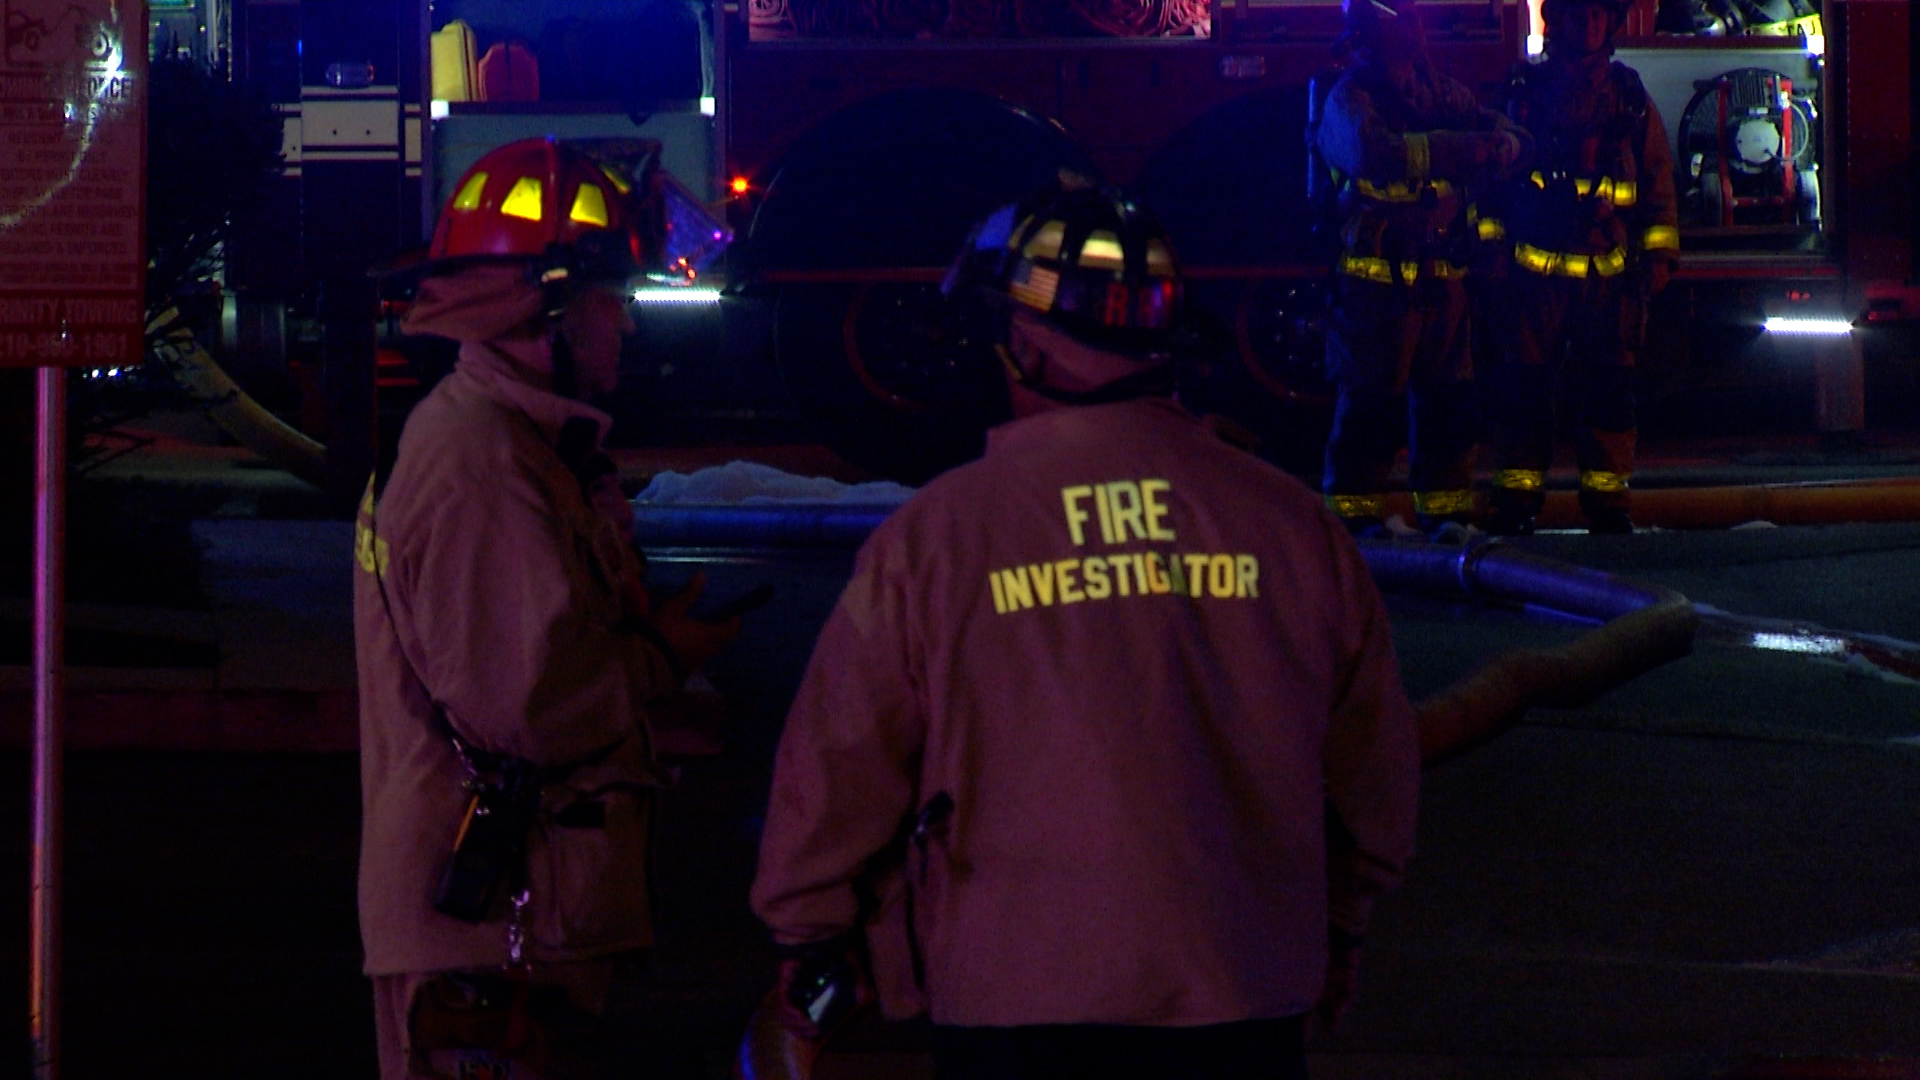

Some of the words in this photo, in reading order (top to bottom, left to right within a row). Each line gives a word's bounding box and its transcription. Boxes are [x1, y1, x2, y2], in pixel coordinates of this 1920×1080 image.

[77, 77, 133, 98] OICE
[0, 241, 53, 254] EQUIRED
[0, 298, 58, 323] RINITY
[63, 298, 138, 323] TOWING
[1061, 478, 1177, 546] FIRE
[988, 551, 1260, 614] INVESTIGATOR
